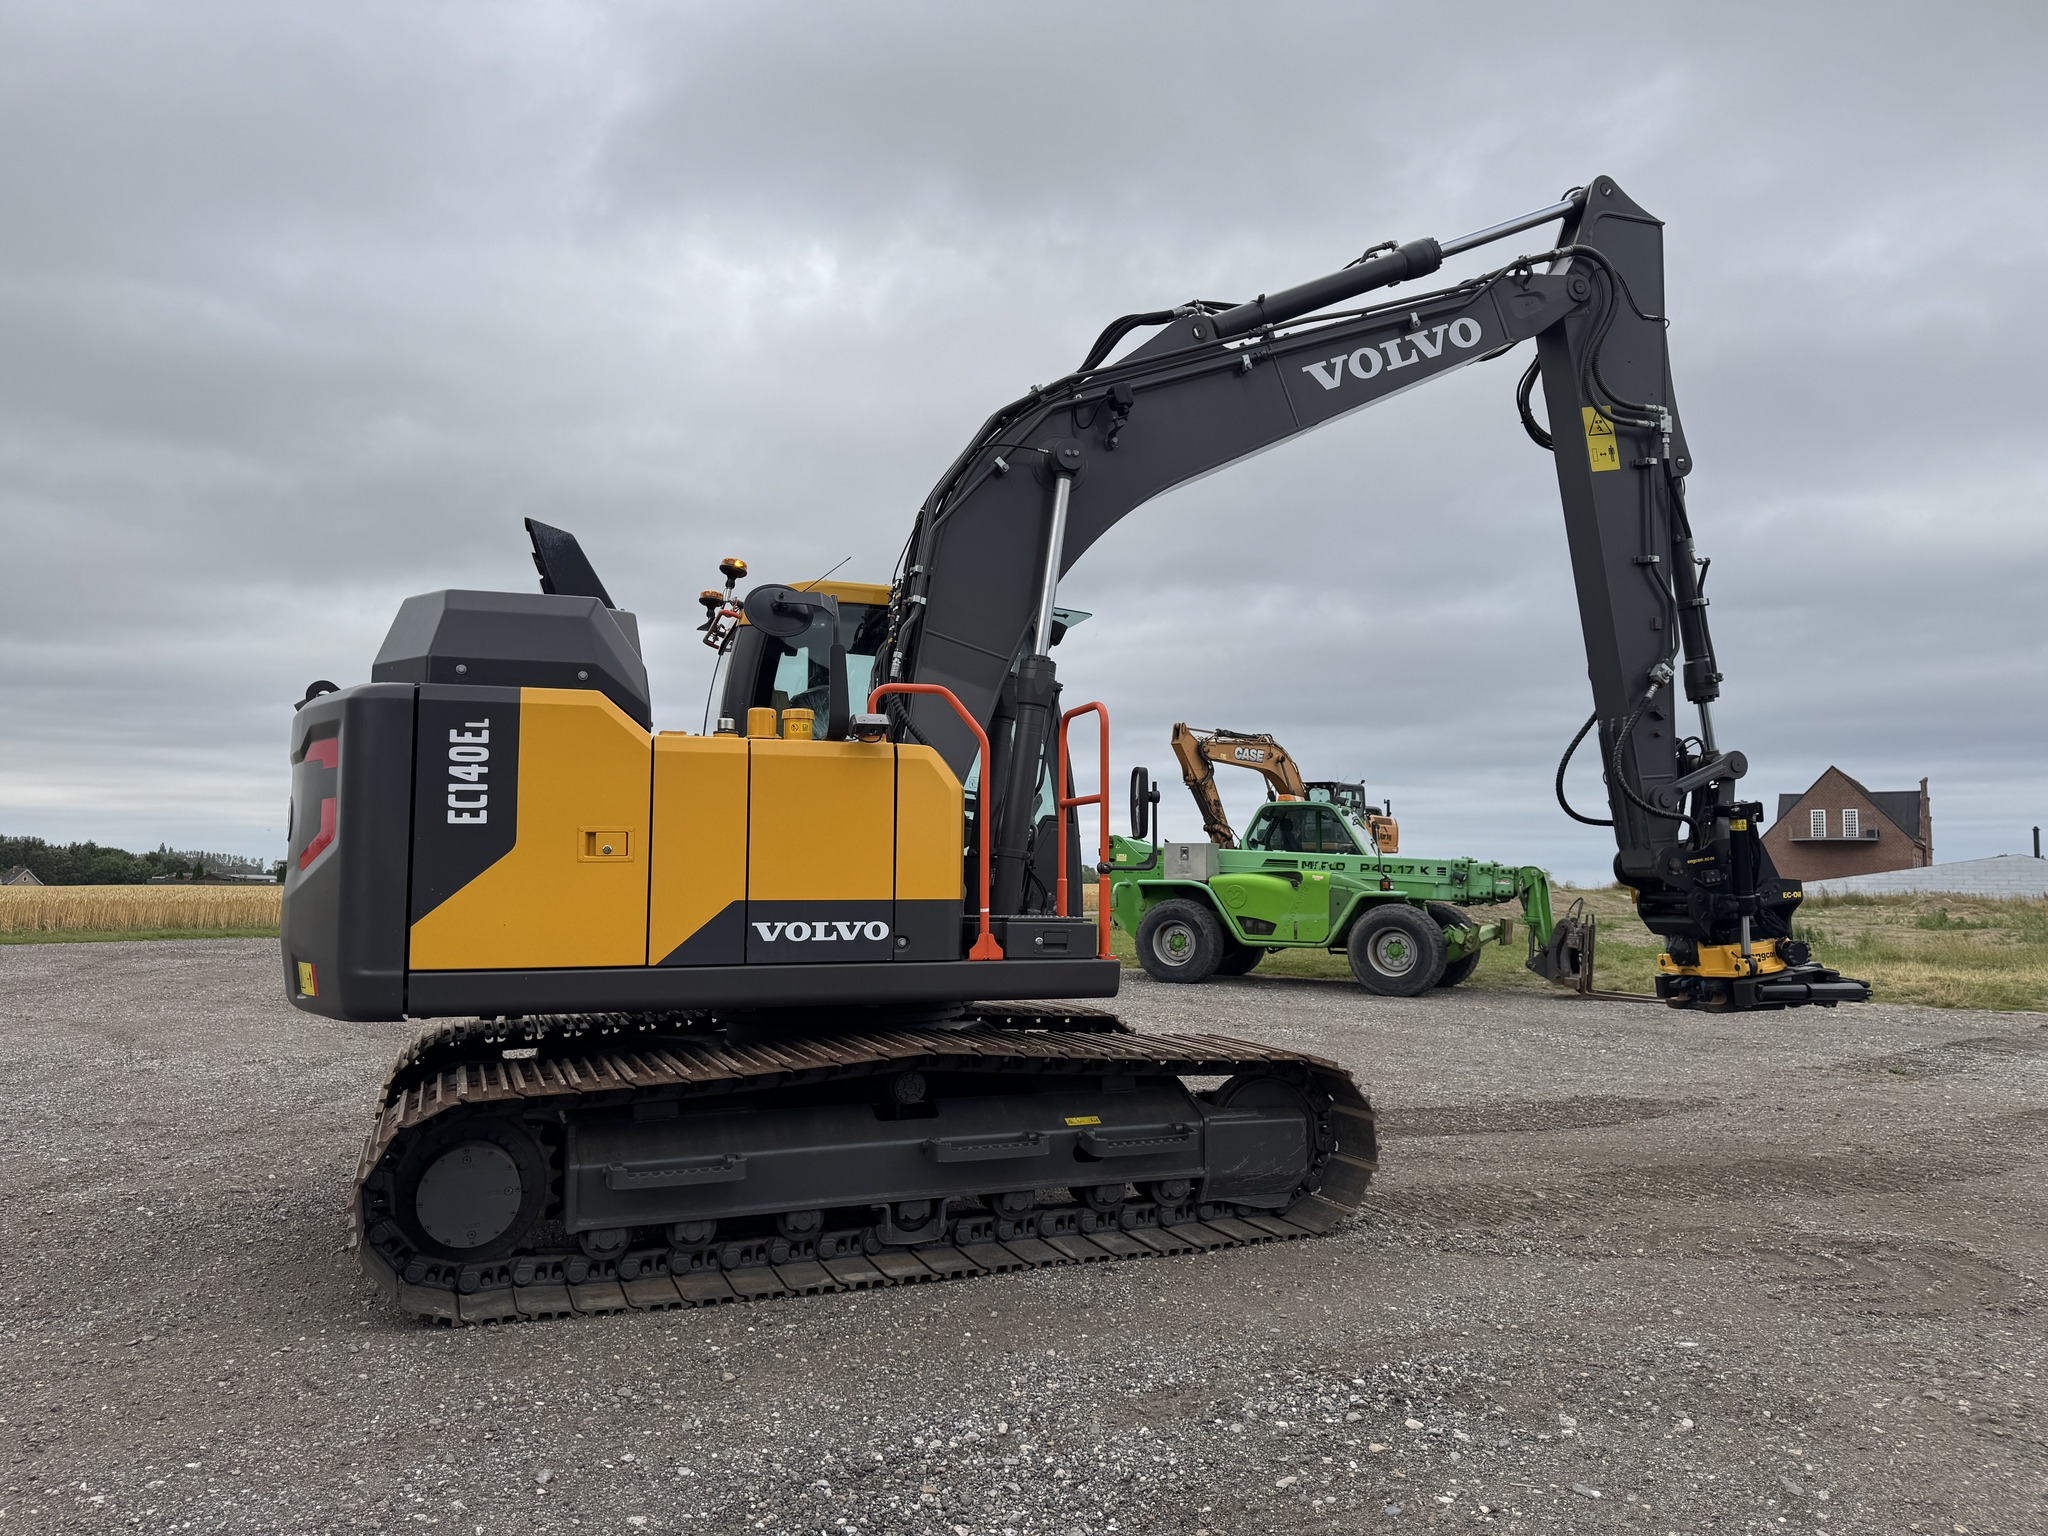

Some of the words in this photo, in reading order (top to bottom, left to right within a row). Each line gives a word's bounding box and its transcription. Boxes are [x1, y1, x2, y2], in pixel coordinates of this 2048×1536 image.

[1302, 318, 1482, 390] VOLVO
[1234, 746, 1265, 763] CASE
[447, 718, 490, 824] EC140EL
[1360, 863, 1415, 875] P40.17
[1420, 866, 1430, 875] K
[751, 920, 890, 942] VOLVO
[1750, 951, 1776, 961] ngco
